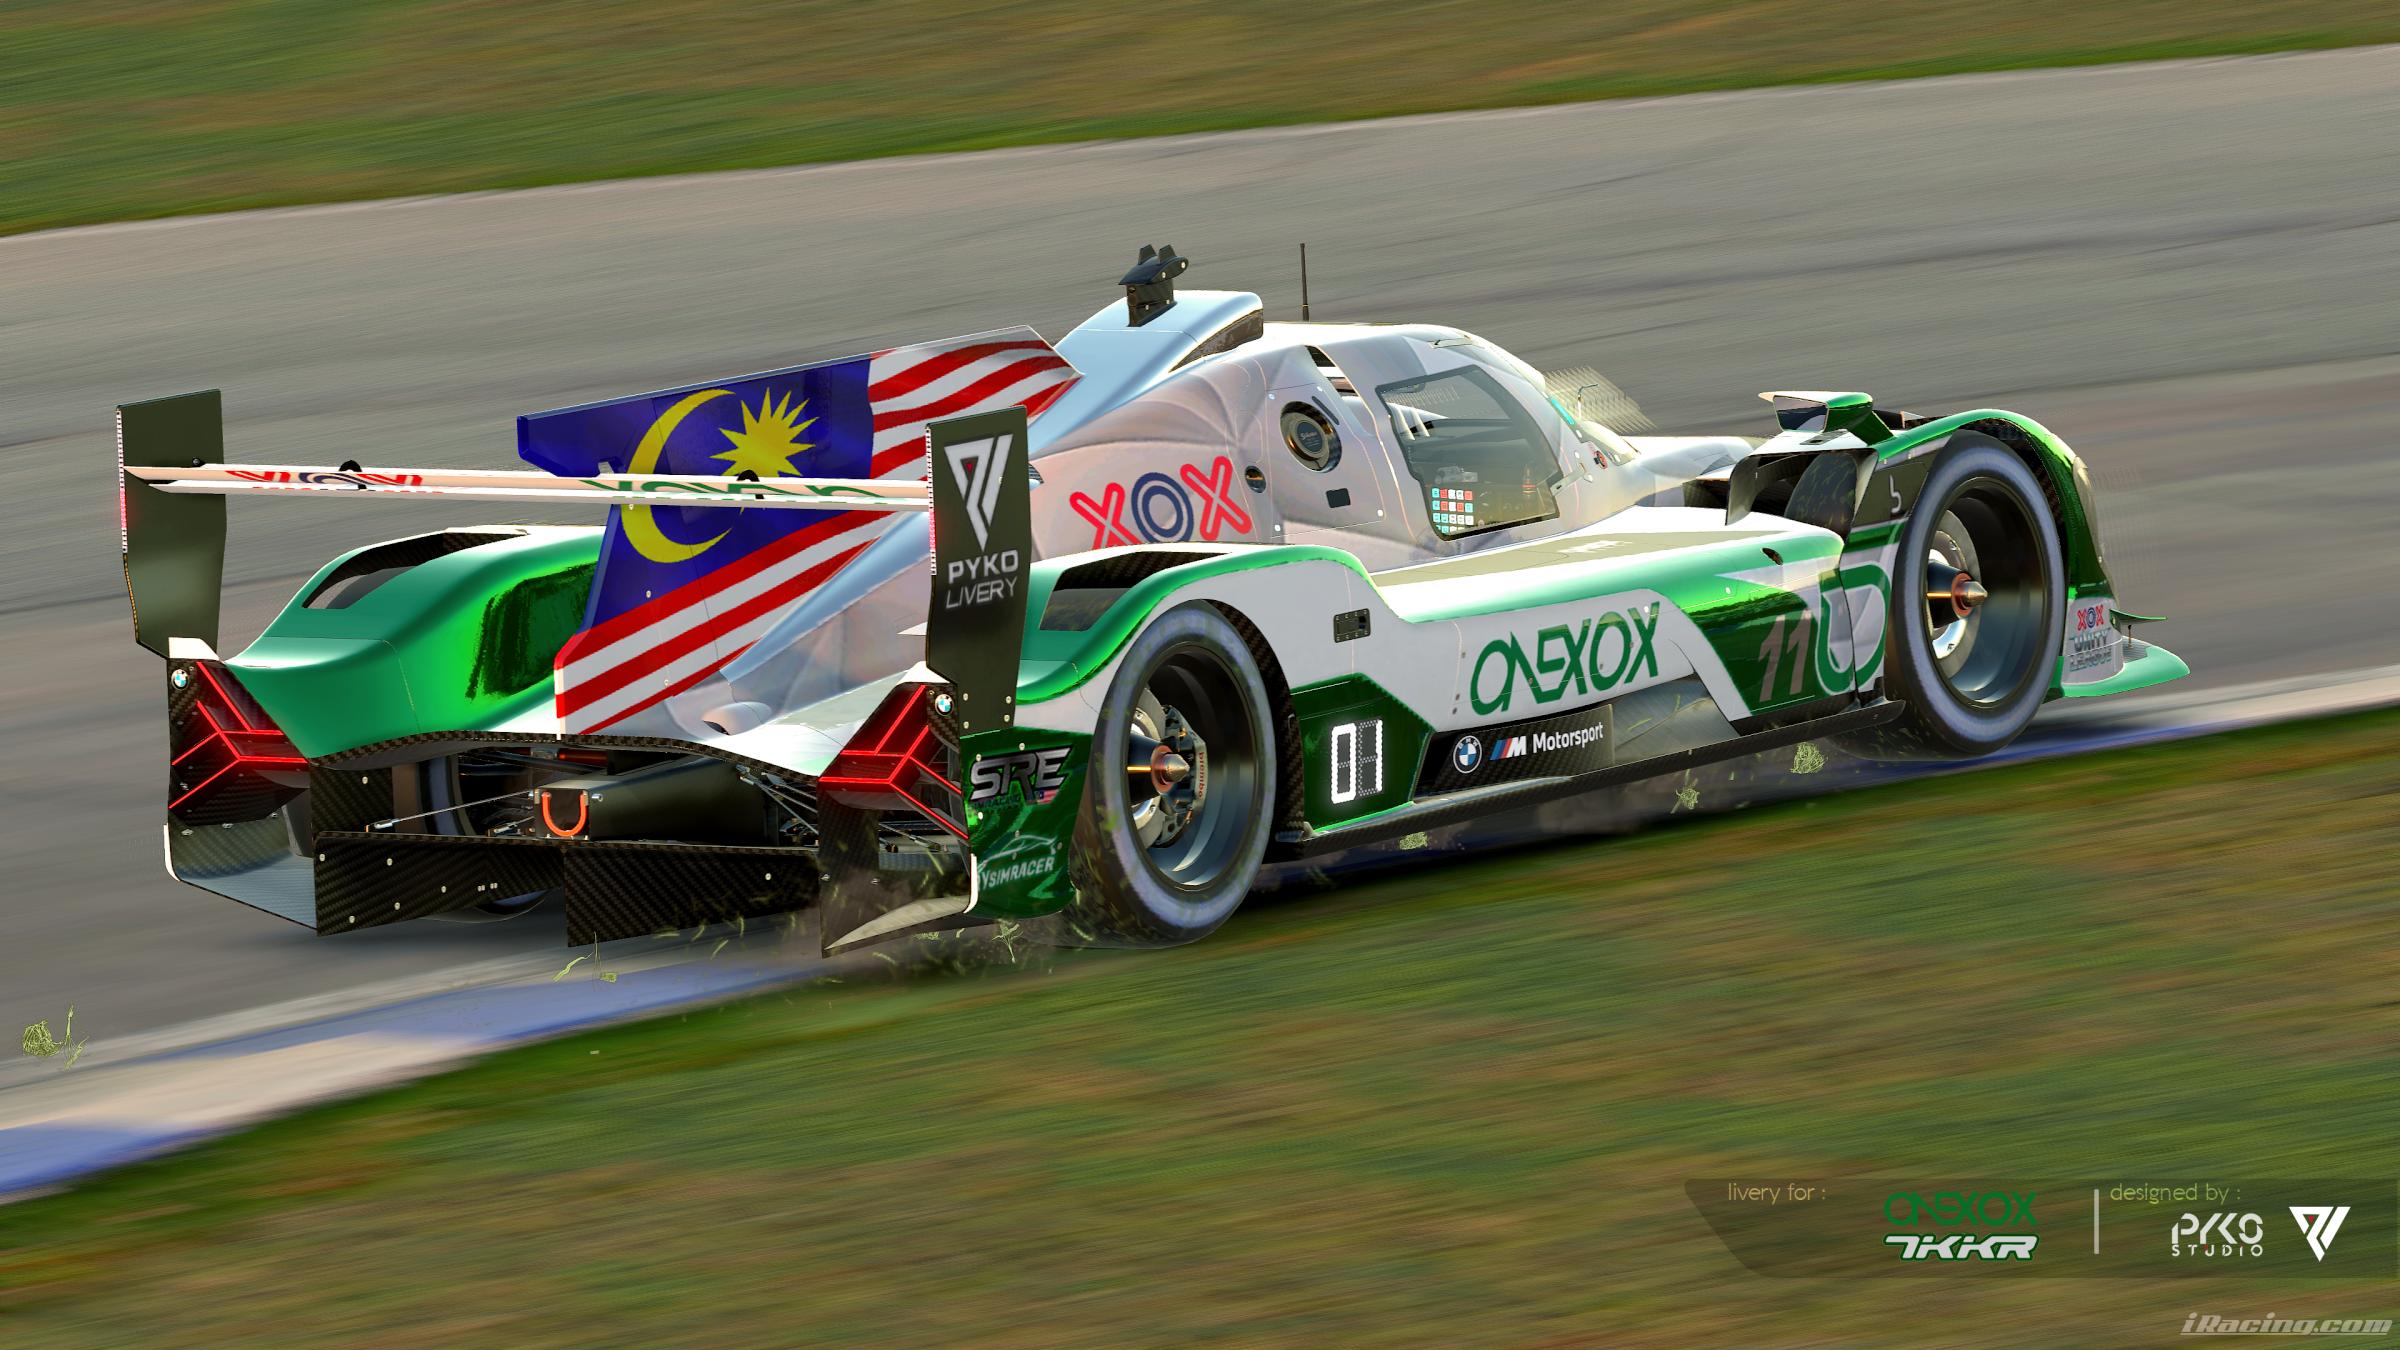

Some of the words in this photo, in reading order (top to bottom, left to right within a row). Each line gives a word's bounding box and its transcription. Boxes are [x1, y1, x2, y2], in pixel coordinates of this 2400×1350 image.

[1069, 456, 1252, 550] XOX
[948, 549, 1019, 584] PYKO
[946, 576, 1018, 609] LIVERY
[2077, 604, 2105, 631] XOX
[1758, 609, 1813, 702] 11
[1533, 721, 1604, 754] Motorsport
[970, 747, 1072, 804] SRE
[1331, 719, 1383, 804] 01
[977, 857, 1055, 892] YSIMRACER
